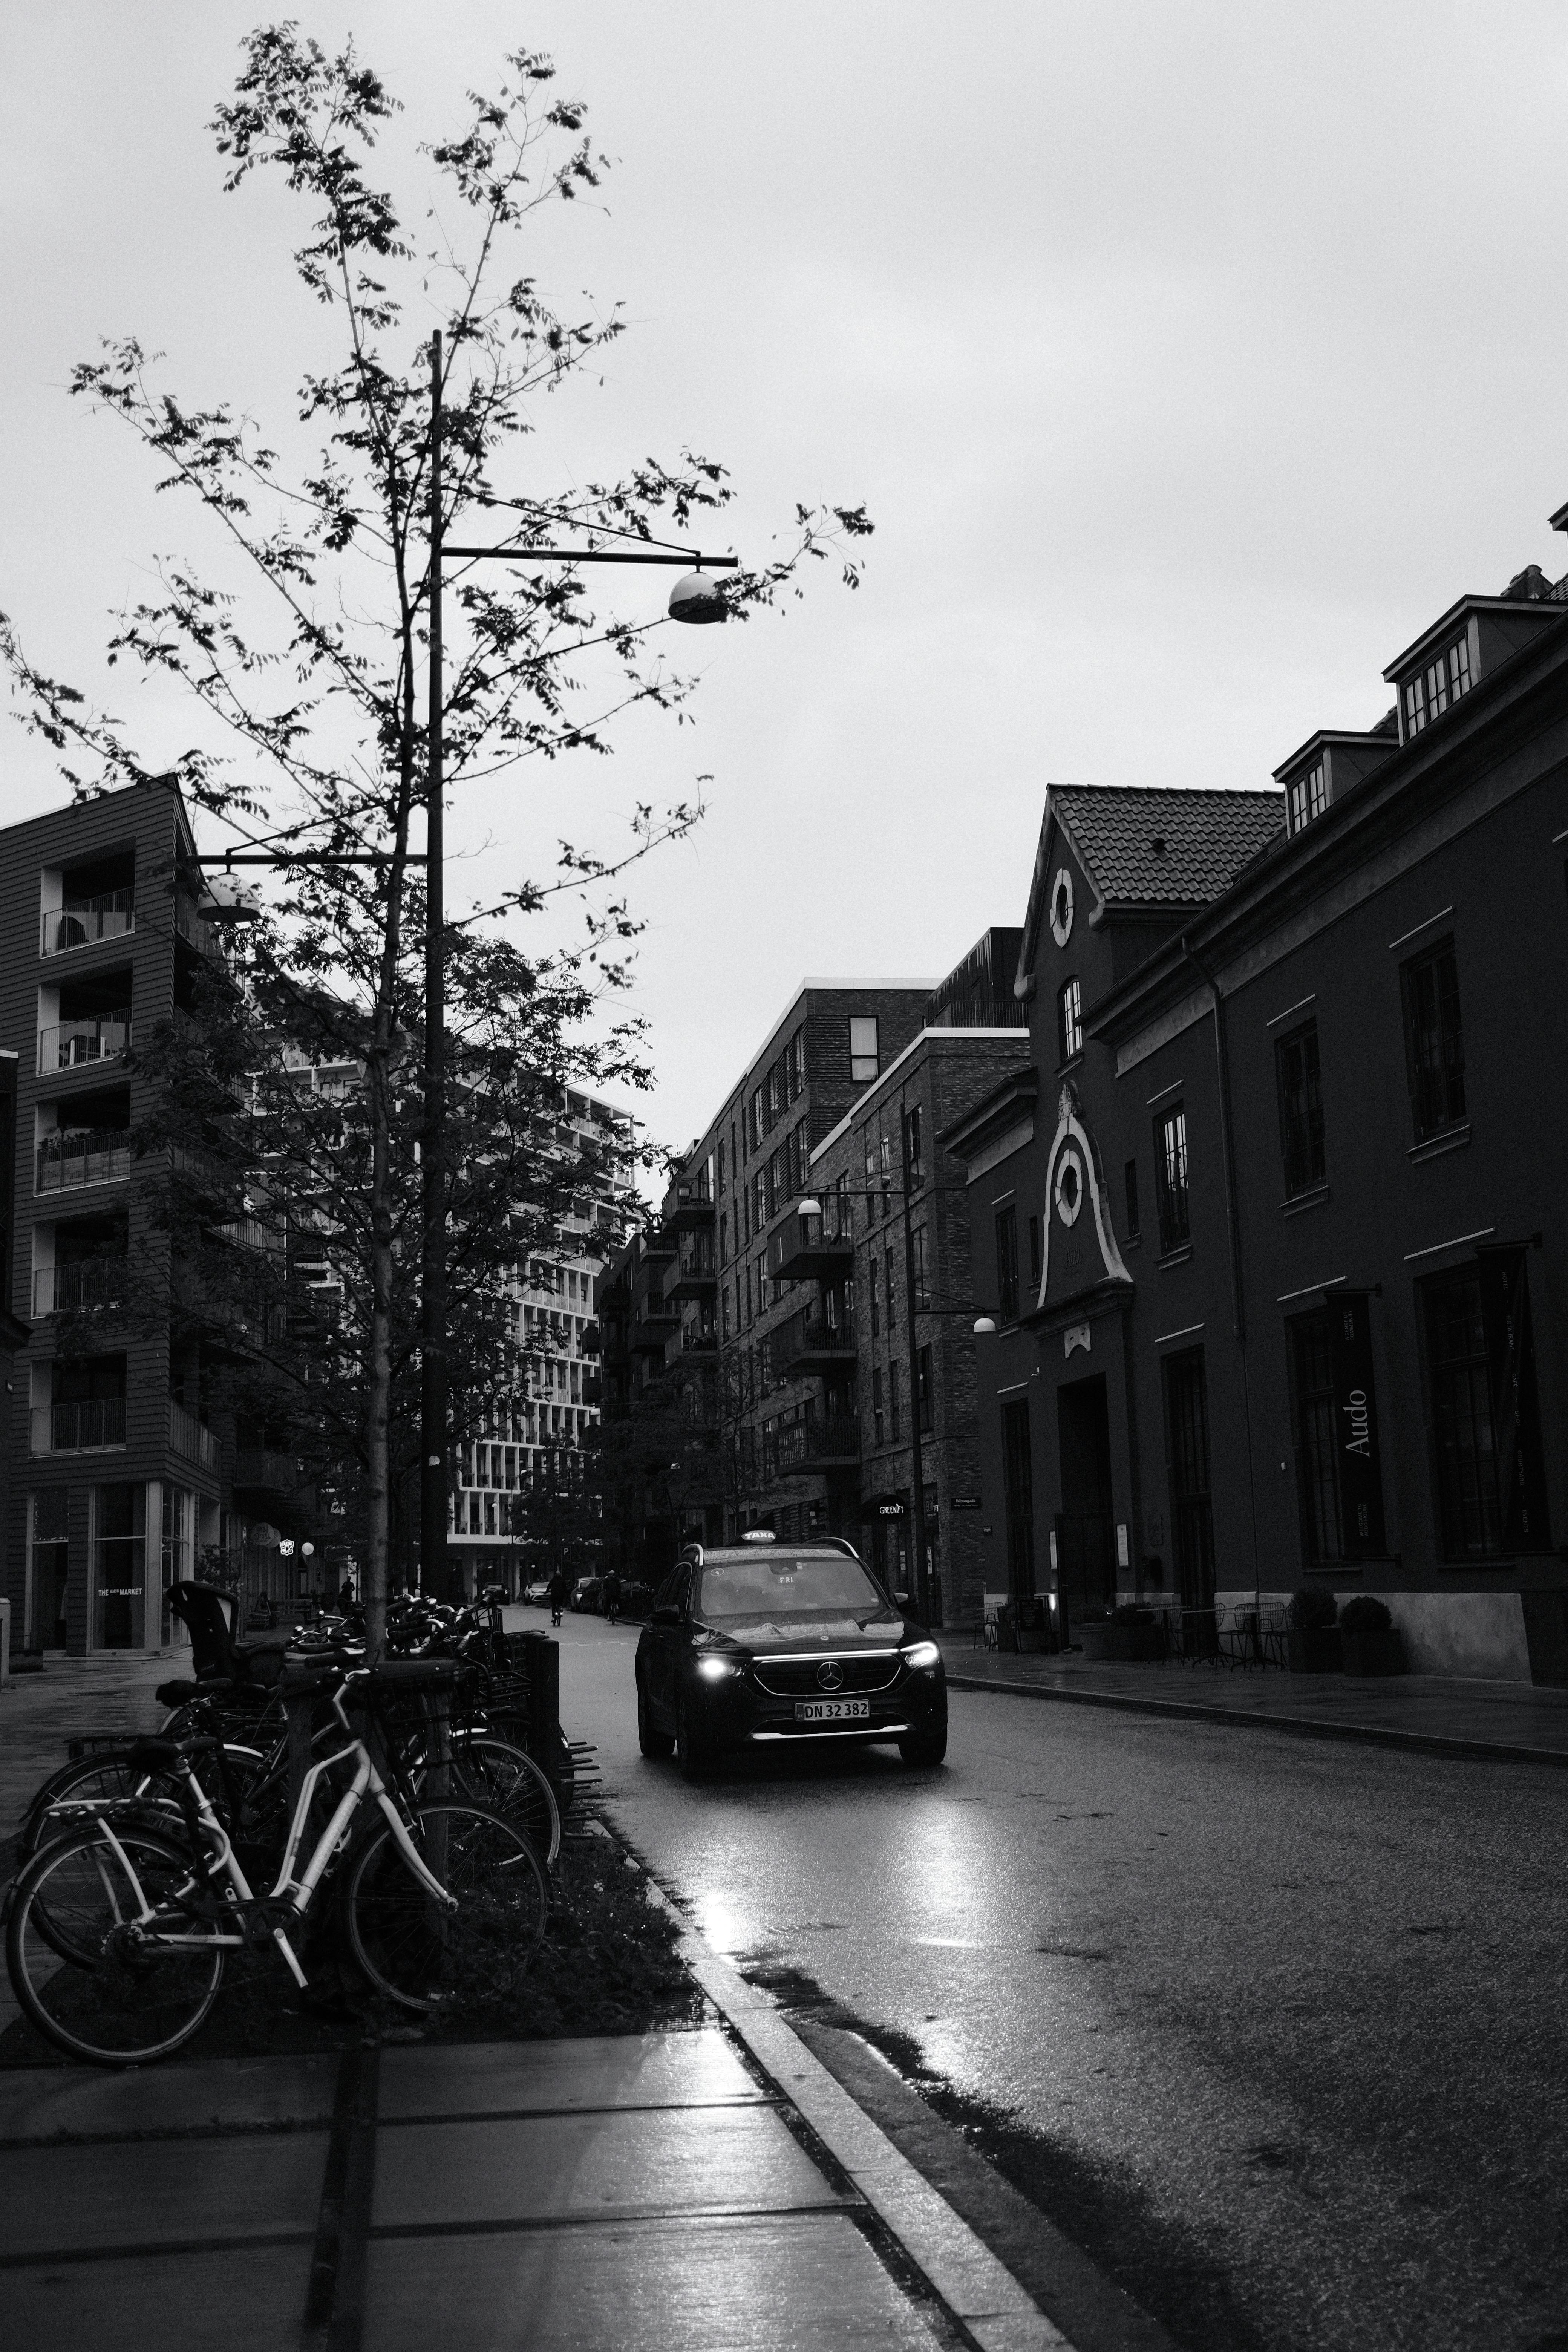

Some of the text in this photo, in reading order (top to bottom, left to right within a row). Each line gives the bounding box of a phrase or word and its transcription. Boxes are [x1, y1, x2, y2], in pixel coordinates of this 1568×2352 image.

[1505, 1313, 1515, 1351] RESTAURANT
[1343, 1390, 1370, 1458] Audo
[879, 1503, 904, 1514] GREENIFY
[564, 1547, 569, 1556] P
[805, 1703, 868, 1718] DN 32 382
